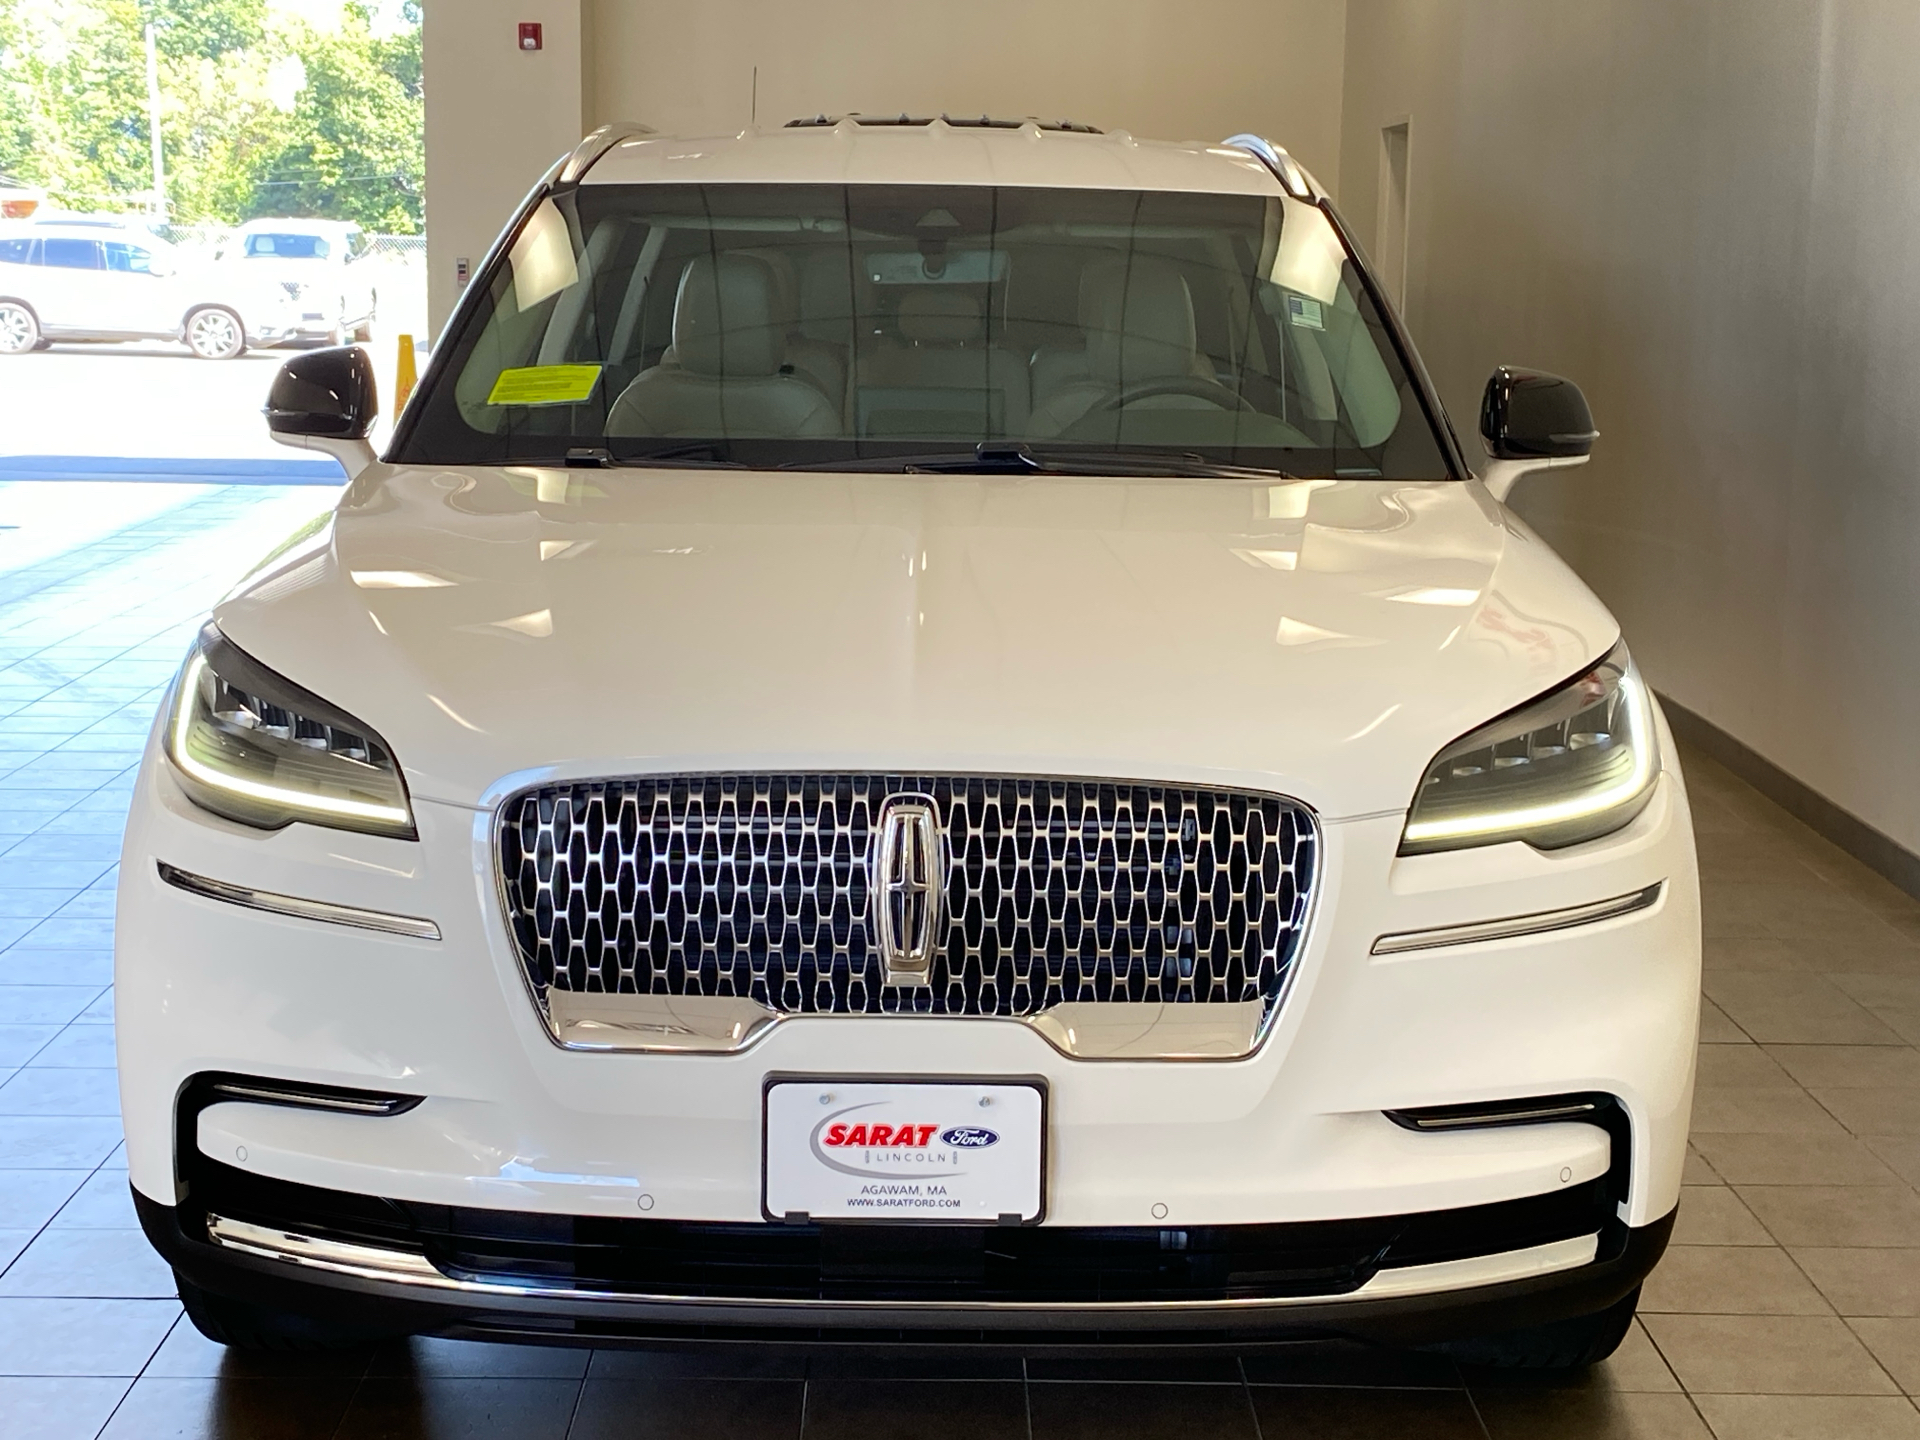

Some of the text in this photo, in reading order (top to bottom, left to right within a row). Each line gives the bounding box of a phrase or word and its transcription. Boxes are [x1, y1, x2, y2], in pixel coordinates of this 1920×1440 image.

[823, 1123, 990, 1148] SARAT Ford
[876, 1153, 946, 1162] LINCOLN
[860, 1185, 947, 1196] AGAWAM, MA
[847, 1198, 961, 1208] WWW.SARATFORD.COM
